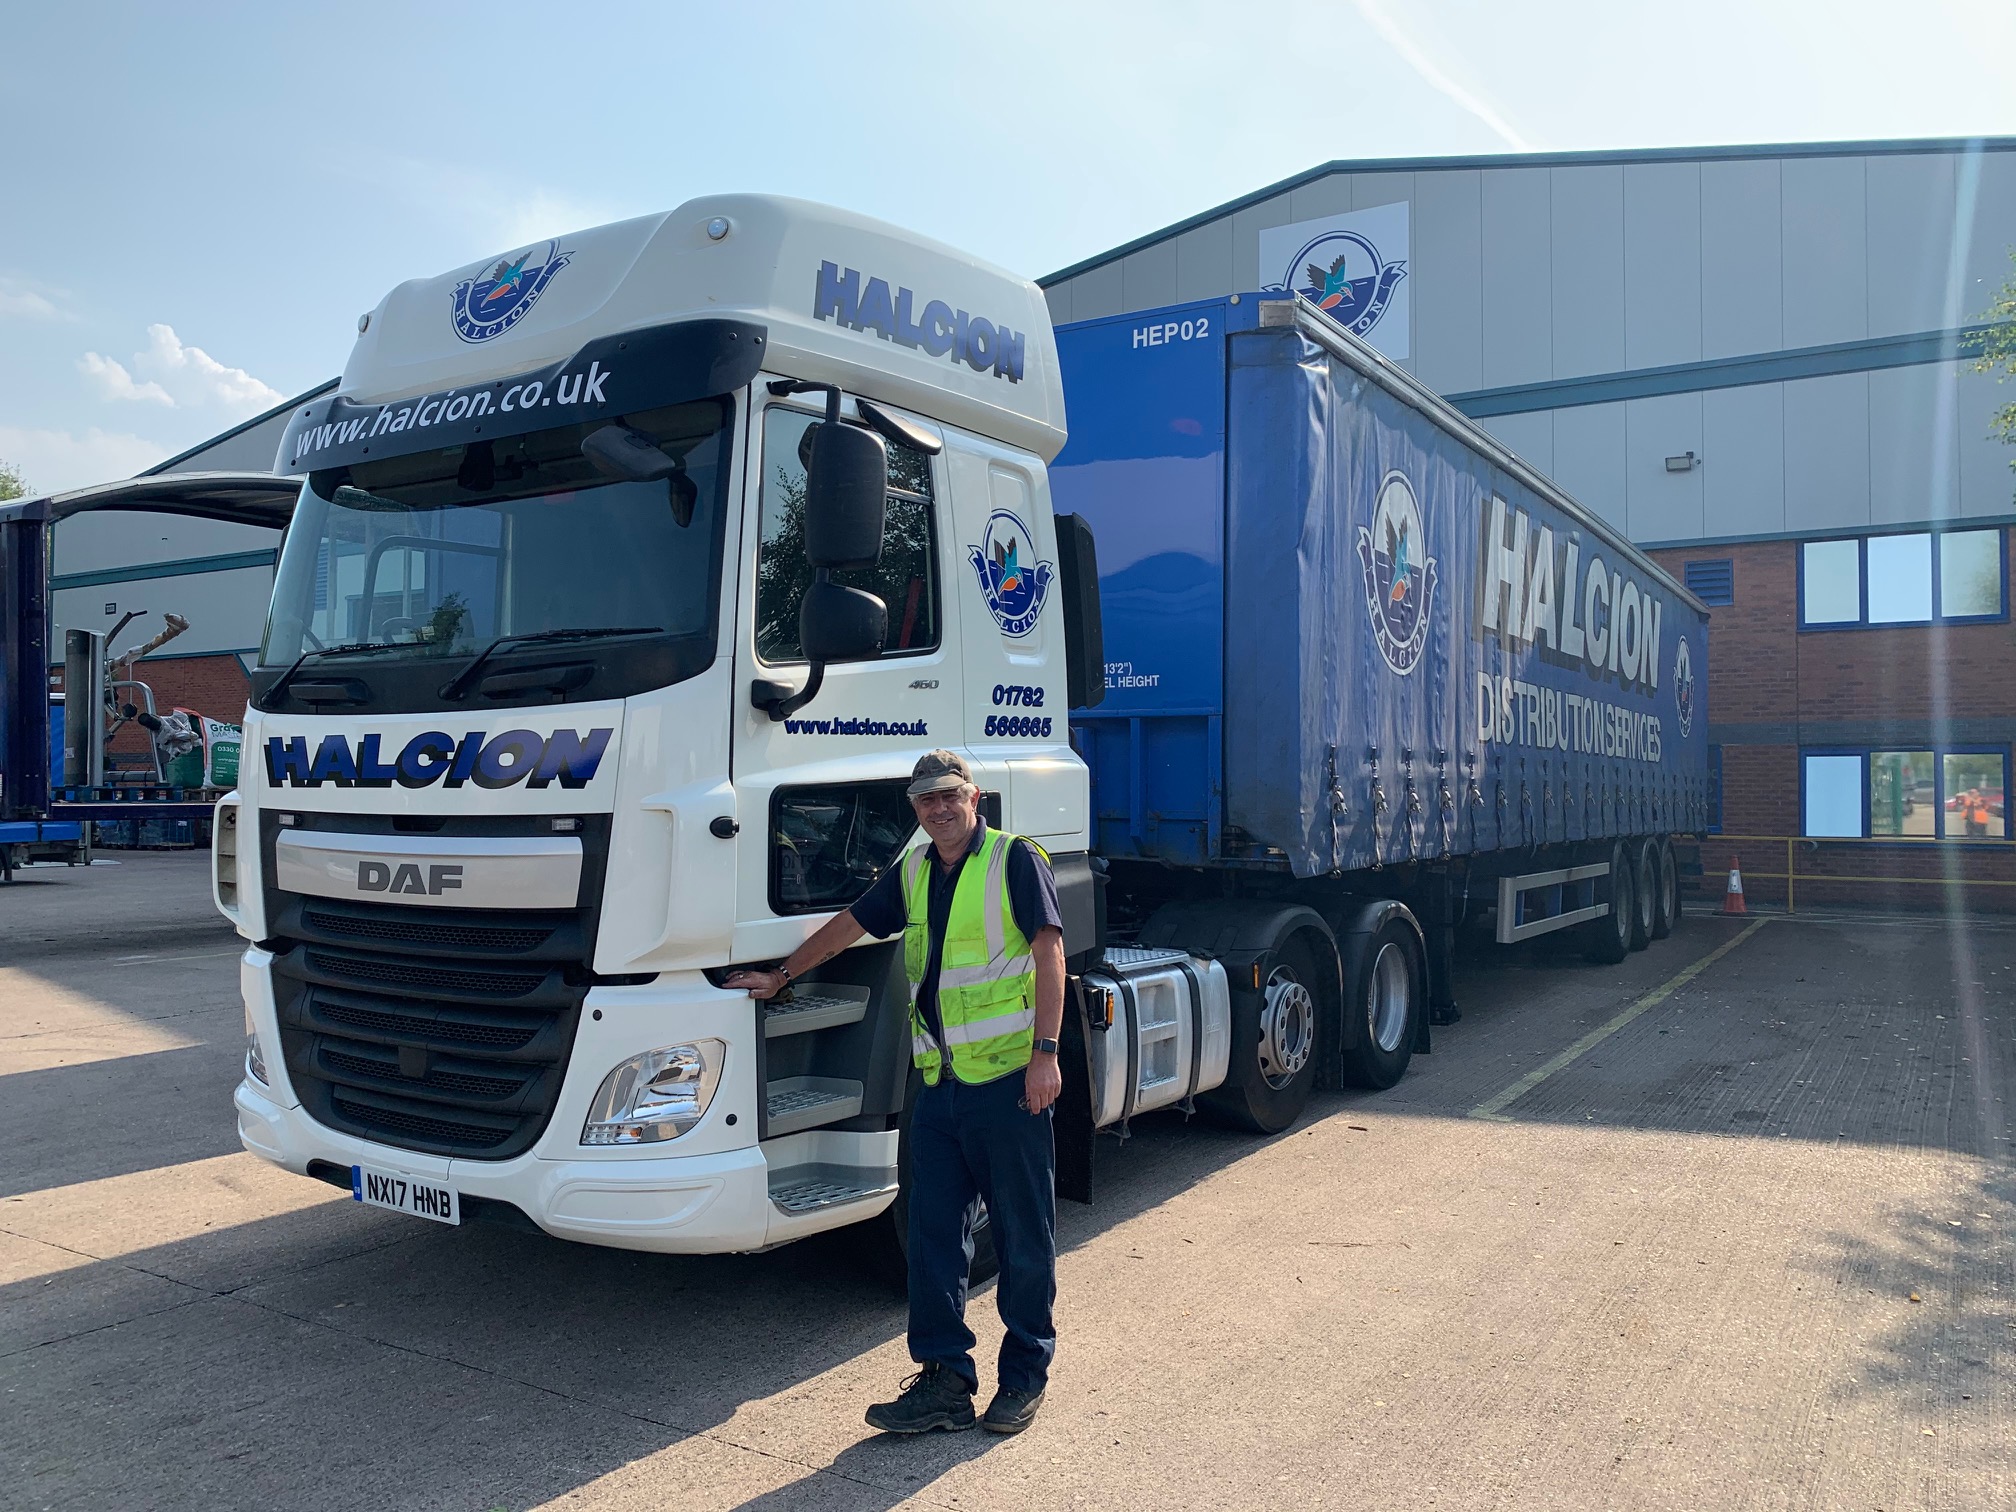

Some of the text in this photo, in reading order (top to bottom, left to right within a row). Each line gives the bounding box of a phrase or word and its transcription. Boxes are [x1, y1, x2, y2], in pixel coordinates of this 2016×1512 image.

[456, 288, 539, 338] HALCION
[813, 260, 1025, 384] HALCION
[1132, 318, 1209, 349] HEP02
[295, 362, 611, 459] www.halcion.co.uk
[1473, 491, 1662, 698] HALCION
[1369, 592, 1427, 667] HALCION
[908, 680, 940, 689] 460
[992, 684, 1044, 707] 01782
[1118, 675, 1160, 688] HEIGHT
[784, 717, 928, 736] www.halcion.co.uk
[984, 715, 1052, 737] 566665
[1477, 670, 1662, 763] DISTRIBUTION SERVICES
[264, 728, 614, 789] HALCION
[357, 860, 463, 896] DAF
[367, 1173, 451, 1218] NX17 HNB
